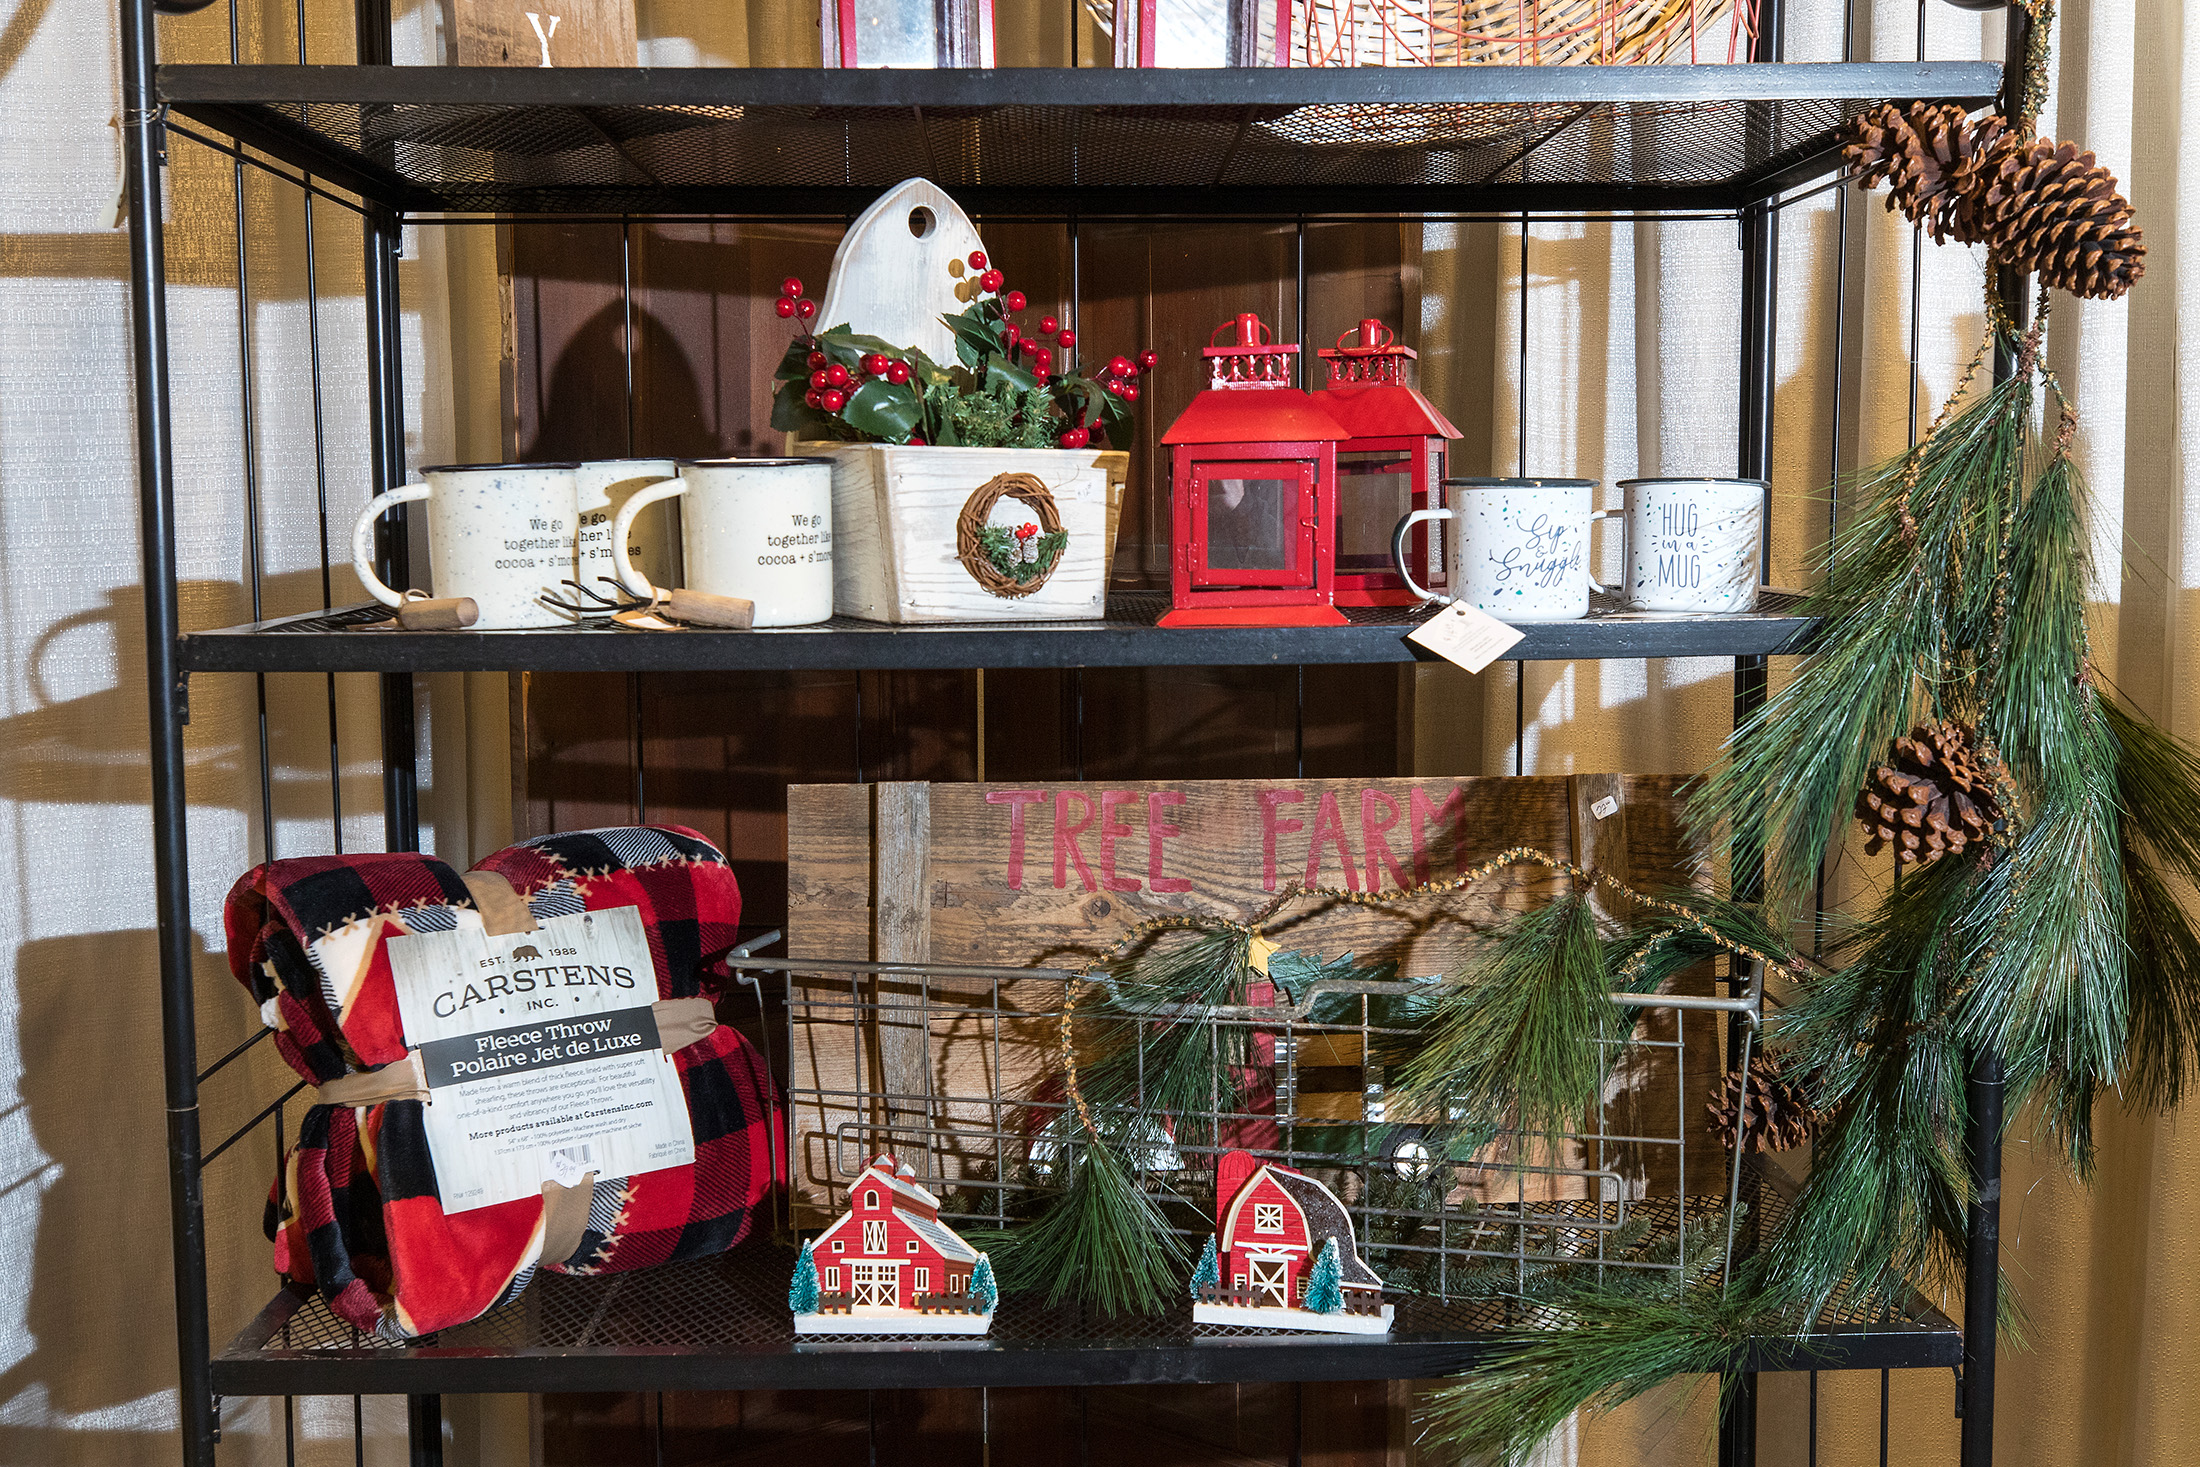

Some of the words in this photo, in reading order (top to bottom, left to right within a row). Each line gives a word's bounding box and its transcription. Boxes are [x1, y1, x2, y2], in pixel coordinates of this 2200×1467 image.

[525, 12, 561, 68] Y
[529, 518, 547, 531] We
[551, 518, 563, 533] go
[579, 514, 588, 525] e
[591, 513, 606, 526] go
[792, 514, 808, 526] We
[811, 514, 821, 528] go
[1662, 503, 1698, 537] HUG
[768, 532, 819, 549] together
[1516, 513, 1570, 550] Sip
[504, 536, 560, 552] together
[1535, 544, 1546, 559] &
[1662, 541, 1682, 552] in
[1686, 541, 1698, 551] a
[495, 558, 535, 569] cocoa
[757, 554, 797, 565] cocoa
[1658, 554, 1701, 588] MUG
[985, 790, 1193, 894] TREE
[1259, 786, 1469, 894] FARM
[479, 956, 506, 968] EST.
[548, 947, 578, 957] 1988
[433, 965, 636, 1018] CARSTENS
[526, 998, 559, 1011] INC.
[475, 1028, 543, 1054] Fleece
[544, 1018, 613, 1040] Throw
[451, 1052, 527, 1078] Polaire
[531, 1043, 561, 1064] Jet
[563, 1038, 590, 1058] de
[593, 1032, 642, 1053] Luxe
[459, 1088, 479, 1097] Made
[480, 1084, 496, 1094] from
[502, 1080, 521, 1089] warm
[521, 1076, 540, 1086] blend
[540, 1074, 549, 1083] of
[548, 1070, 564, 1081] thick
[585, 1065, 601, 1075] lined
[602, 1062, 616, 1072] with
[616, 1060, 634, 1070] super
[634, 1057, 646, 1067] soft
[507, 1089, 525, 1099] these
[525, 1086, 548, 1096] throws
[548, 1084, 559, 1092] are
[560, 1077, 596, 1090] exceptional.
[610, 1069, 637, 1080] beautiful
[456, 1106, 503, 1119] one-of-a-kind
[503, 1099, 529, 1111] comfort
[530, 1094, 561, 1106] anywhere
[562, 1092, 575, 1101] you
[602, 1083, 616, 1092] love
[616, 1081, 628, 1090] the
[628, 1077, 656, 1088] versatility
[508, 1111, 522, 1120] and
[523, 1106, 550, 1118] vibrancy
[550, 1104, 558, 1112] of
[558, 1102, 569, 1111] our
[570, 1098, 590, 1108] Fleece
[468, 1130, 494, 1141] More
[495, 1122, 534, 1138] products
[535, 1114, 574, 1128] available
[574, 1113, 584, 1121] at
[584, 1100, 654, 1119] CarstensInc.com
[672, 1139, 685, 1147] China
